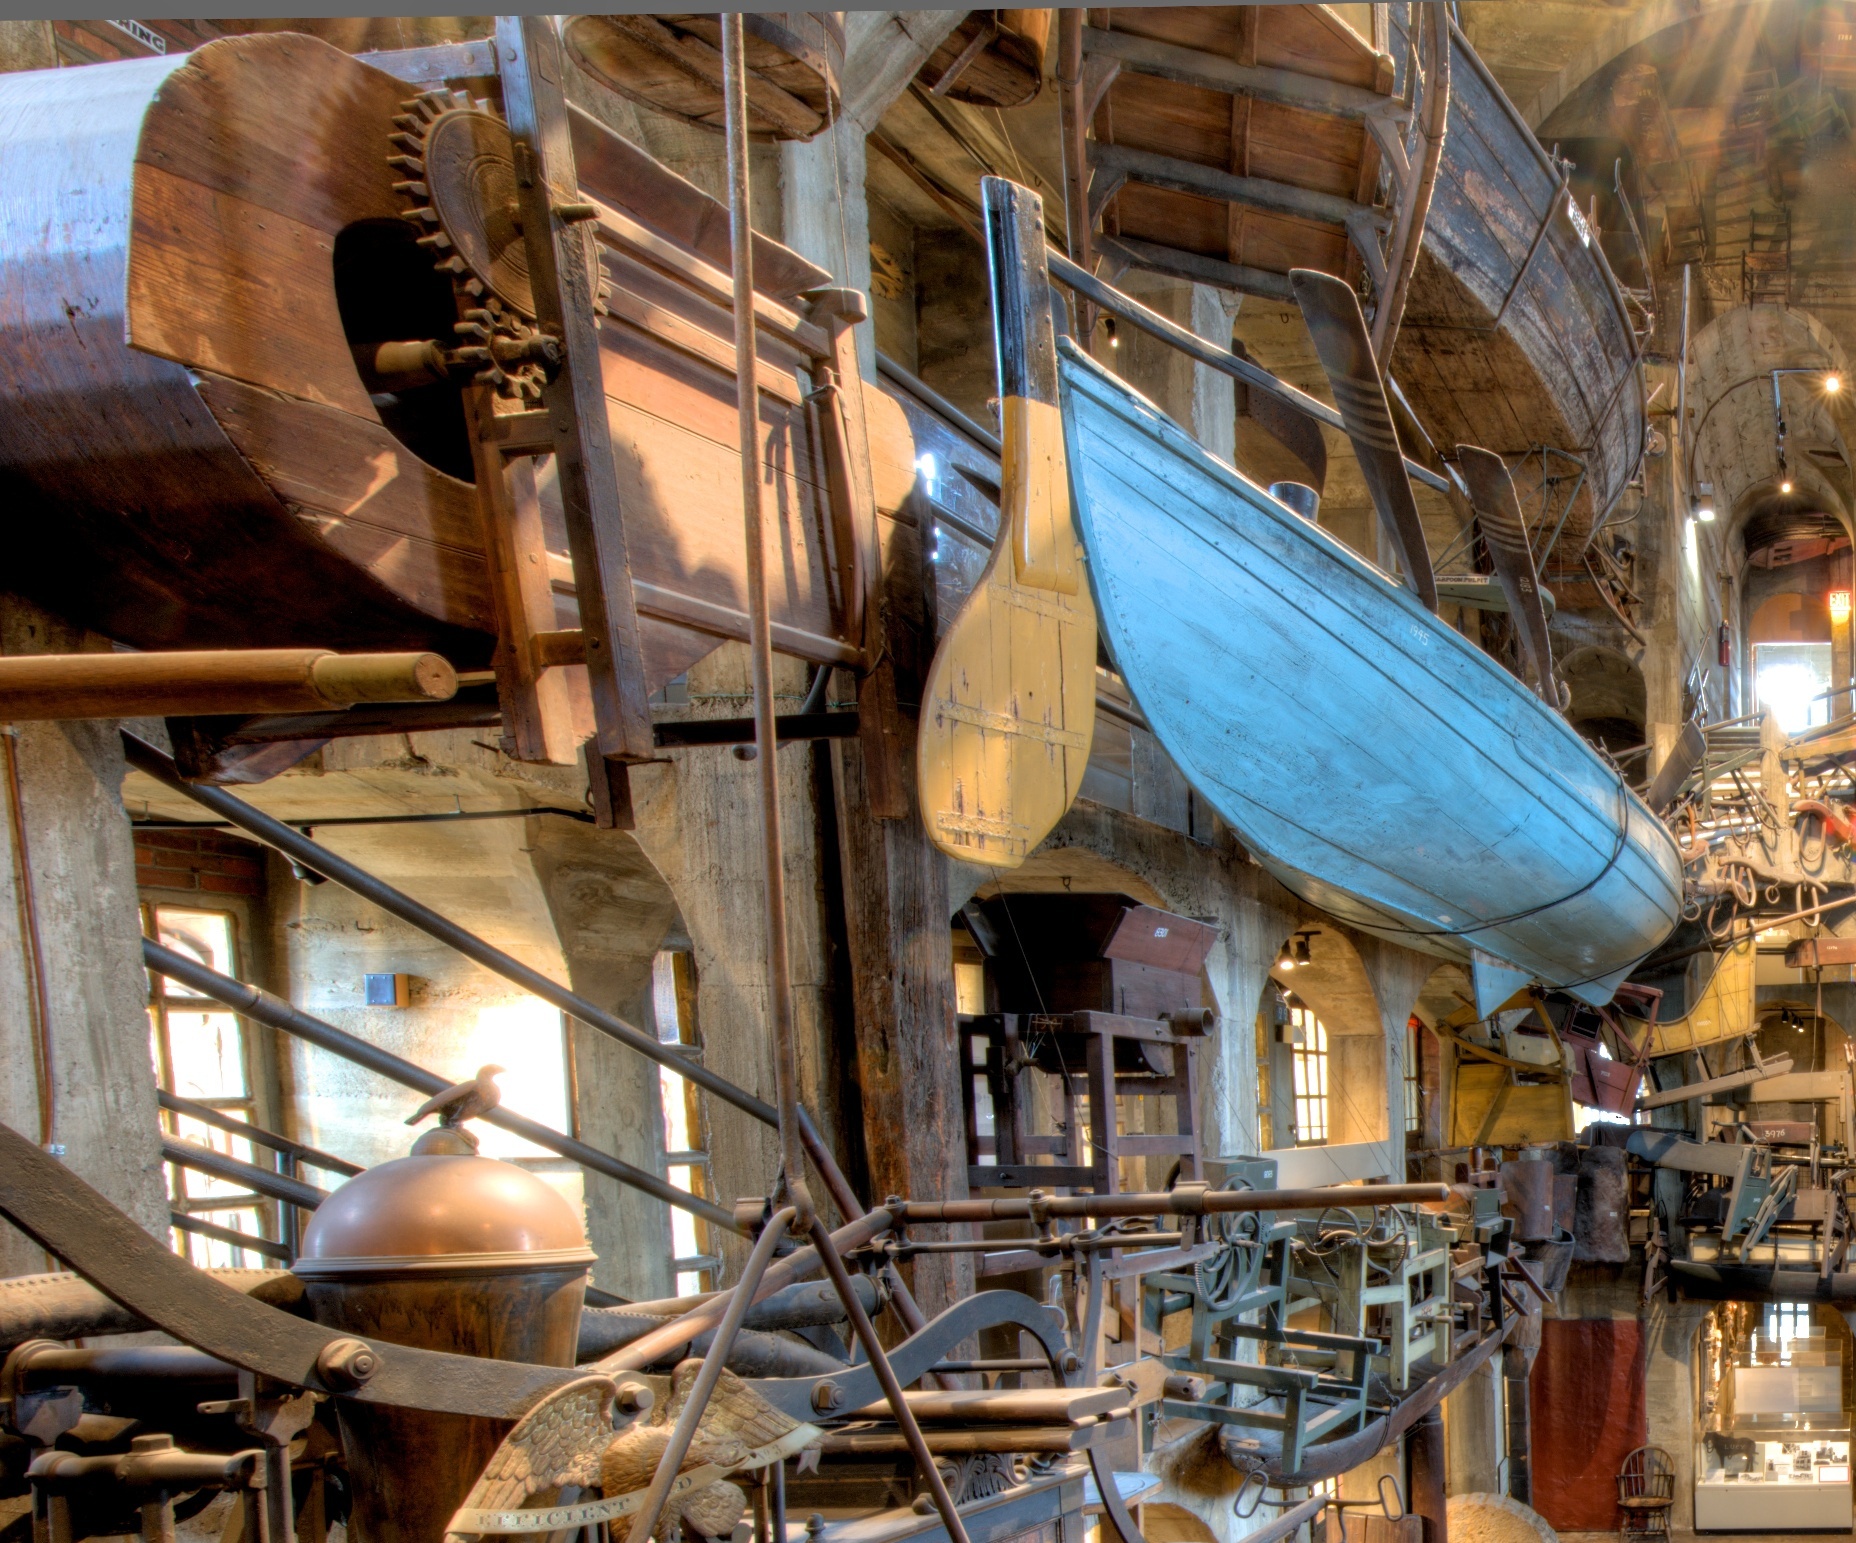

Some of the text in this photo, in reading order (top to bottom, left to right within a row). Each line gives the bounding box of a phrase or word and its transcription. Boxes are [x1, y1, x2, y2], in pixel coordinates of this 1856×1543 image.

[1830, 592, 1850, 606] EXIT
[1765, 1129, 1786, 1139] 3976
[475, 1497, 631, 1527] EFFICIENT
